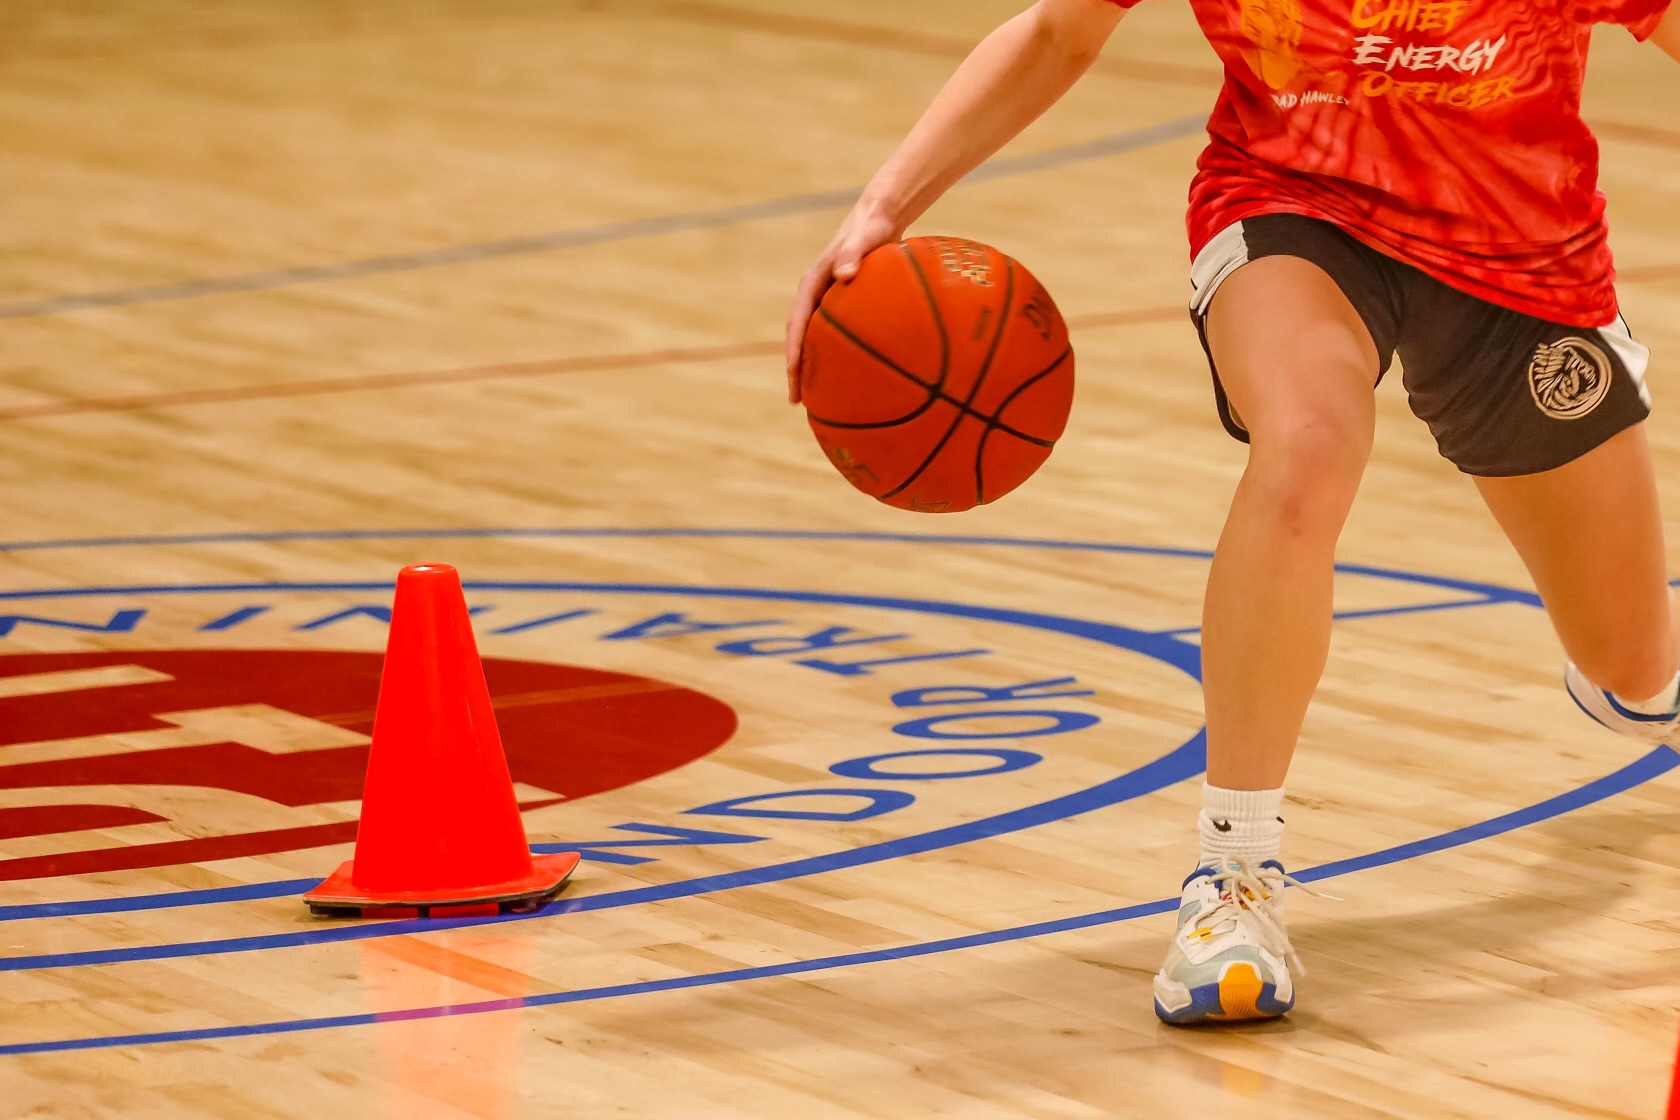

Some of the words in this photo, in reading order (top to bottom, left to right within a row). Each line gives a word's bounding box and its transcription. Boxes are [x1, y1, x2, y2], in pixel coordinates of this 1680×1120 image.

[1351, 34, 1507, 76] ENERGY
[1300, 90, 1350, 108] HAWLEY
[1359, 71, 1517, 109] OFFICER
[530, 676, 1102, 865] NDOOR
